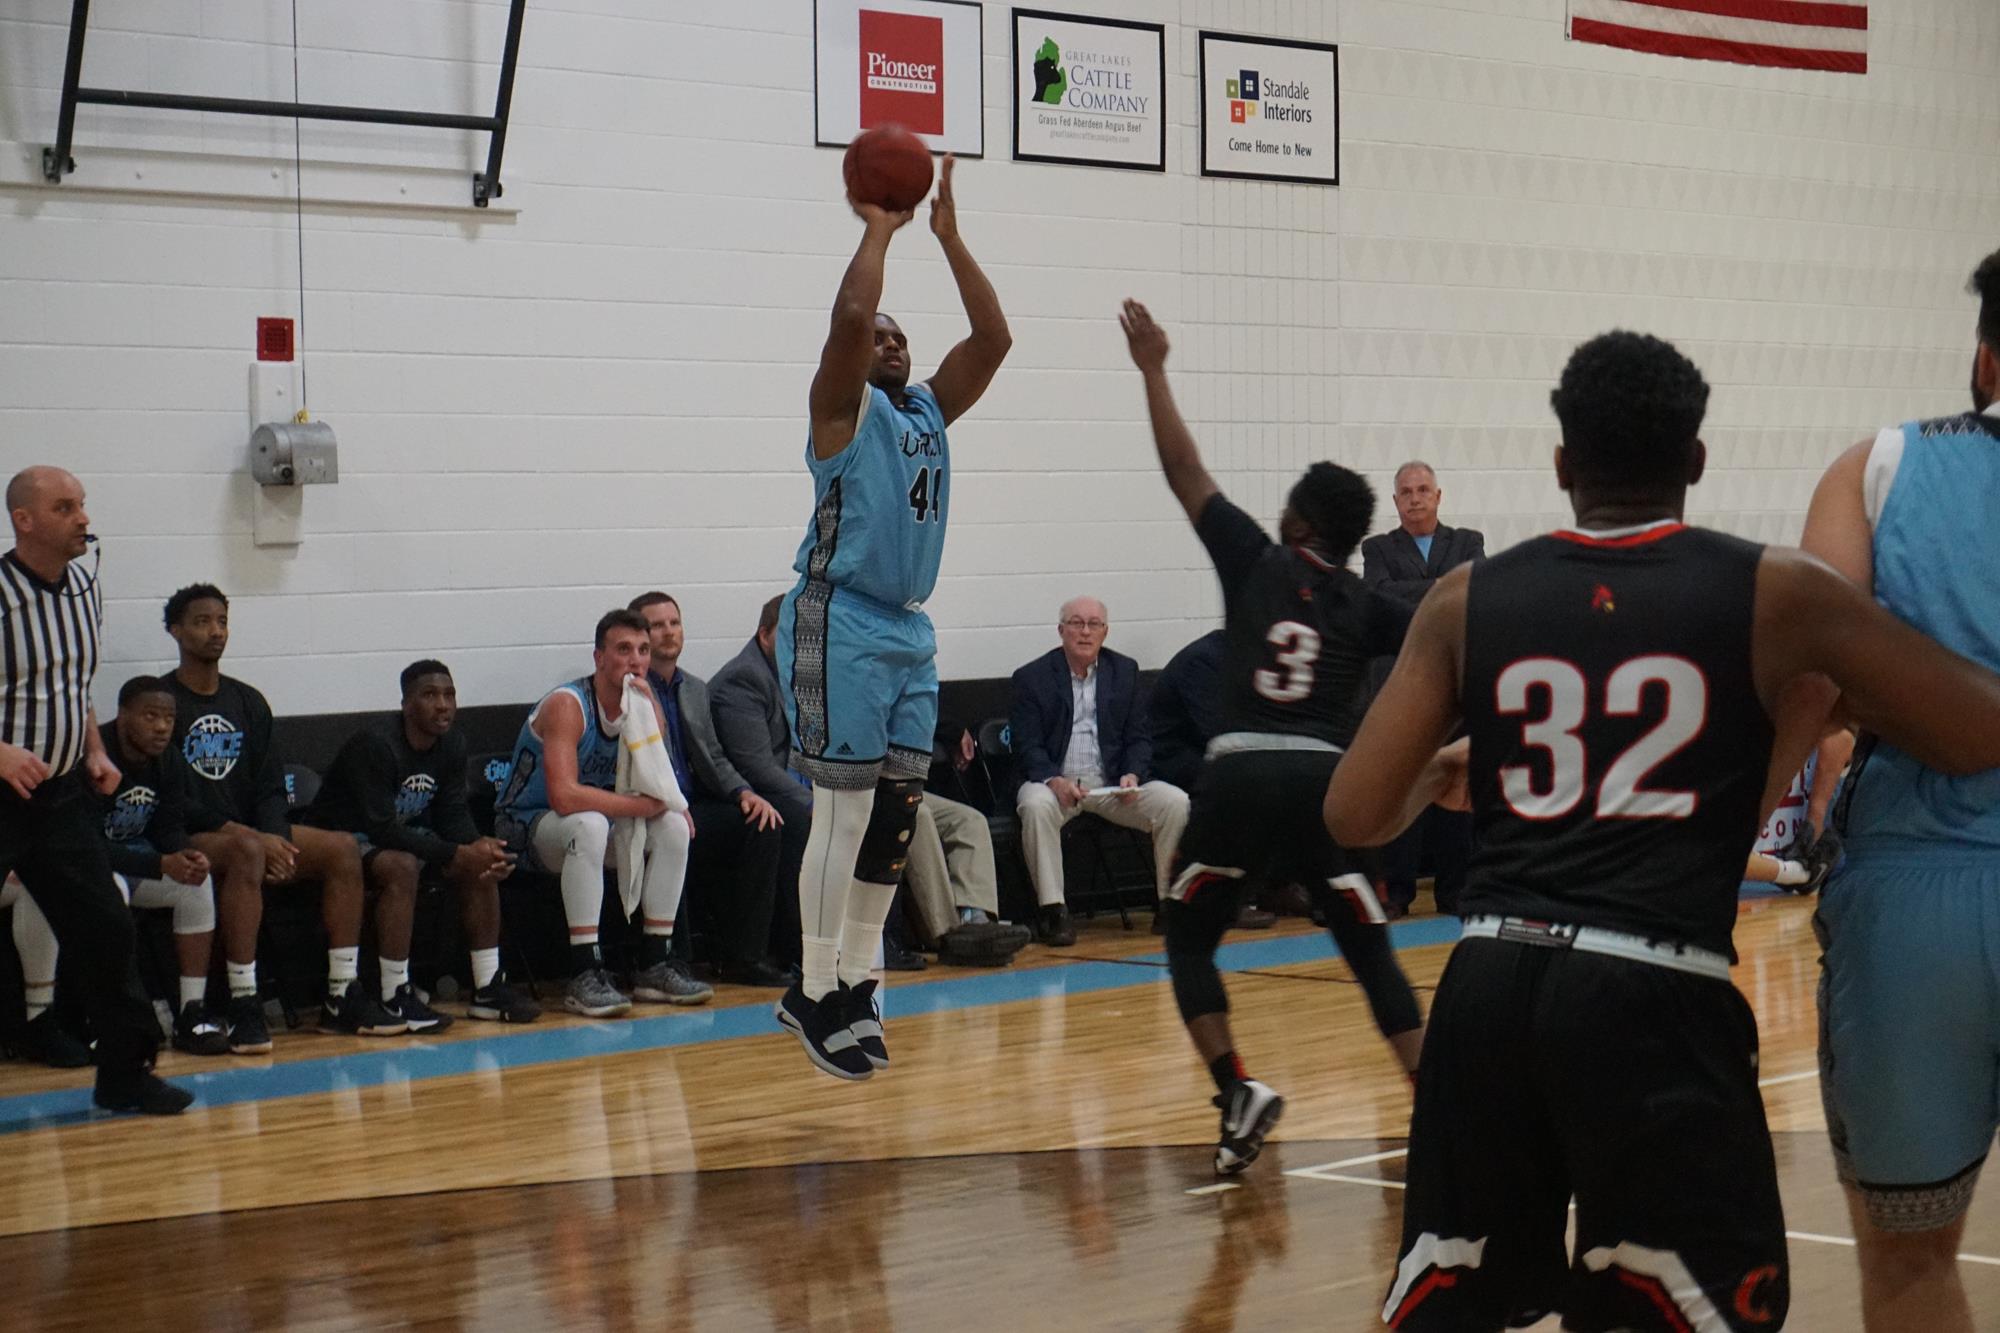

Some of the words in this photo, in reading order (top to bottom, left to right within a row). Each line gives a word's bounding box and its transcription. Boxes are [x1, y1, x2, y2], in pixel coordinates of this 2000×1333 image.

[867, 52, 936, 80] Pioneer
[1065, 50, 1097, 63] GREAT
[1101, 53, 1132, 67] LAKES
[870, 79, 934, 91] CONSTRUCTION
[1071, 65, 1132, 90] CATTLE
[1263, 78, 1309, 100] Standale
[1068, 88, 1148, 113] COMPANY
[1264, 101, 1312, 123] Interiors
[1038, 114, 1058, 126] Grass
[1059, 115, 1071, 127] Fed
[1073, 117, 1103, 130] Aberdeen
[1105, 120, 1125, 133] Angus
[1127, 122, 1141, 133] Beef
[1228, 138, 1252, 152] Come
[1256, 140, 1279, 154] Home
[1283, 144, 1291, 155] to
[1295, 143, 1312, 156] New
[1252, 620, 1322, 703] 3
[1496, 655, 1708, 820] 32
